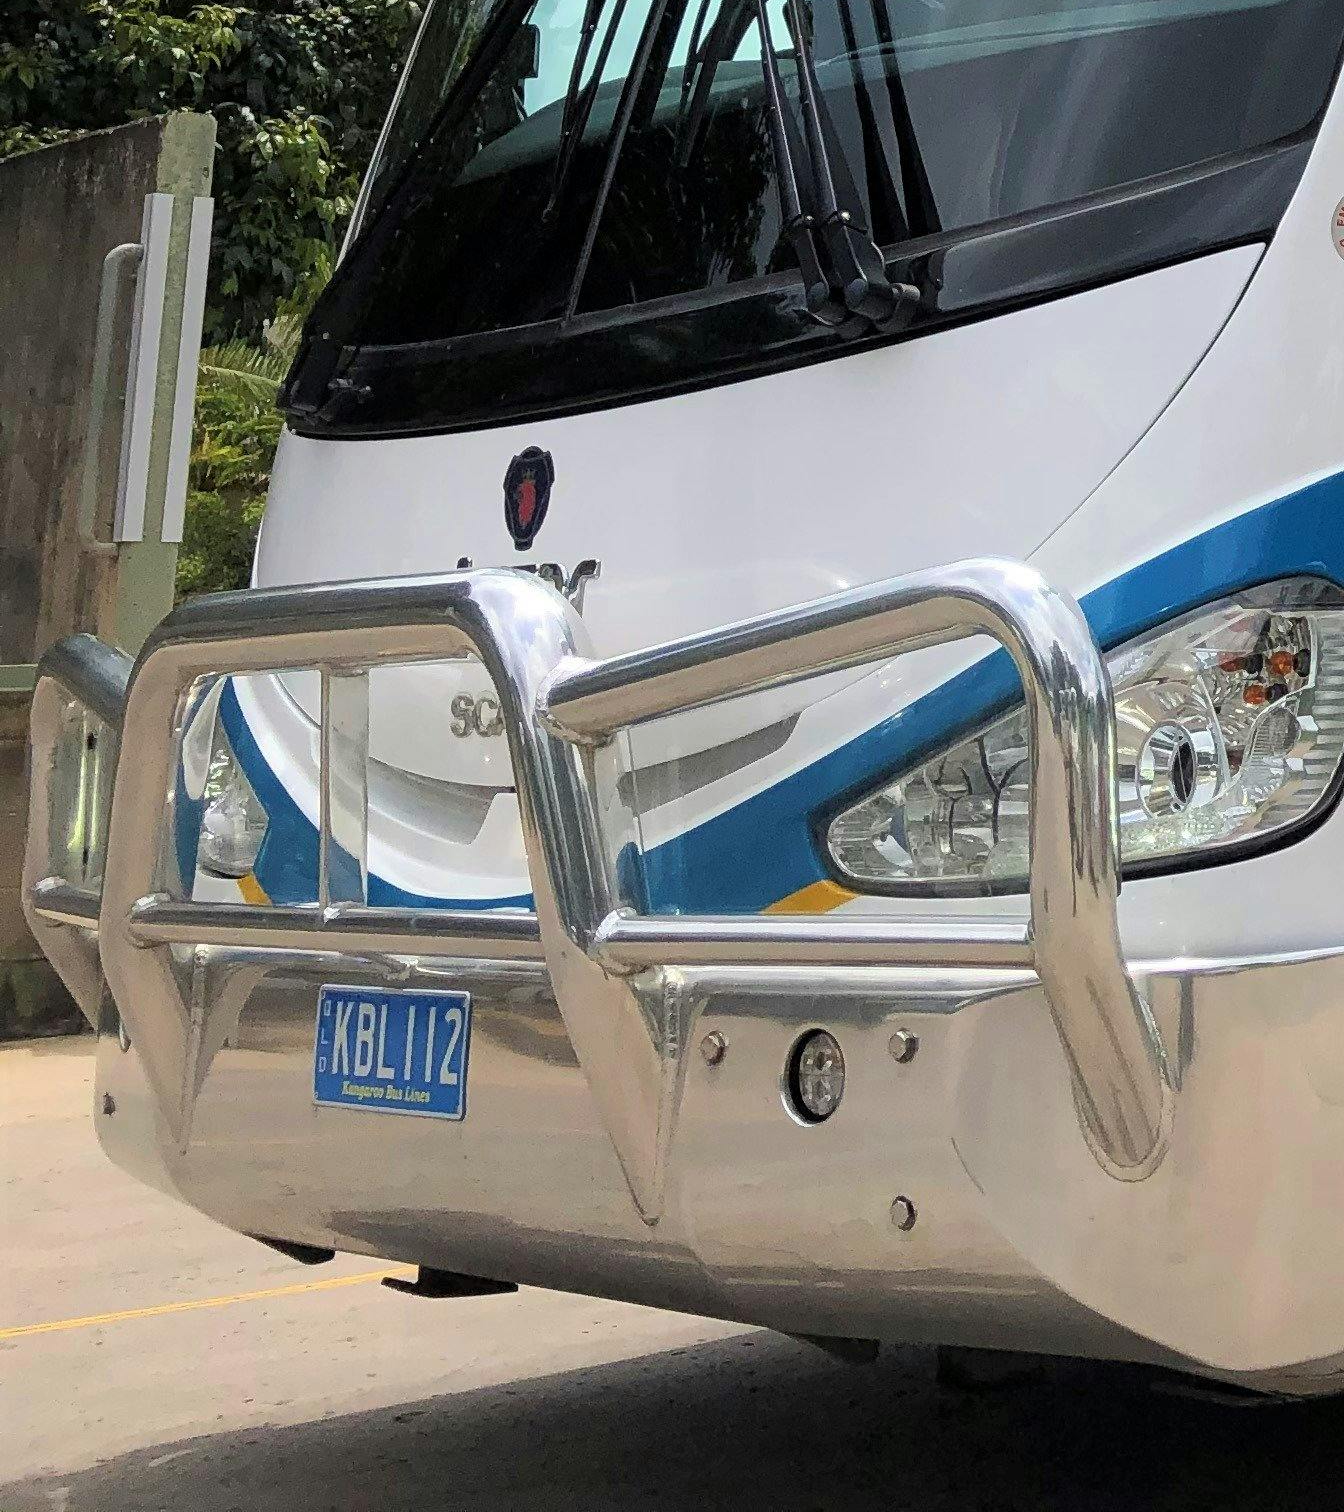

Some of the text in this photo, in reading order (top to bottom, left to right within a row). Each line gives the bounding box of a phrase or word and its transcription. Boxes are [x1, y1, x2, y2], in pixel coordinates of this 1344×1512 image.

[341, 1080, 430, 1103] Kangaroo Bus Lines
